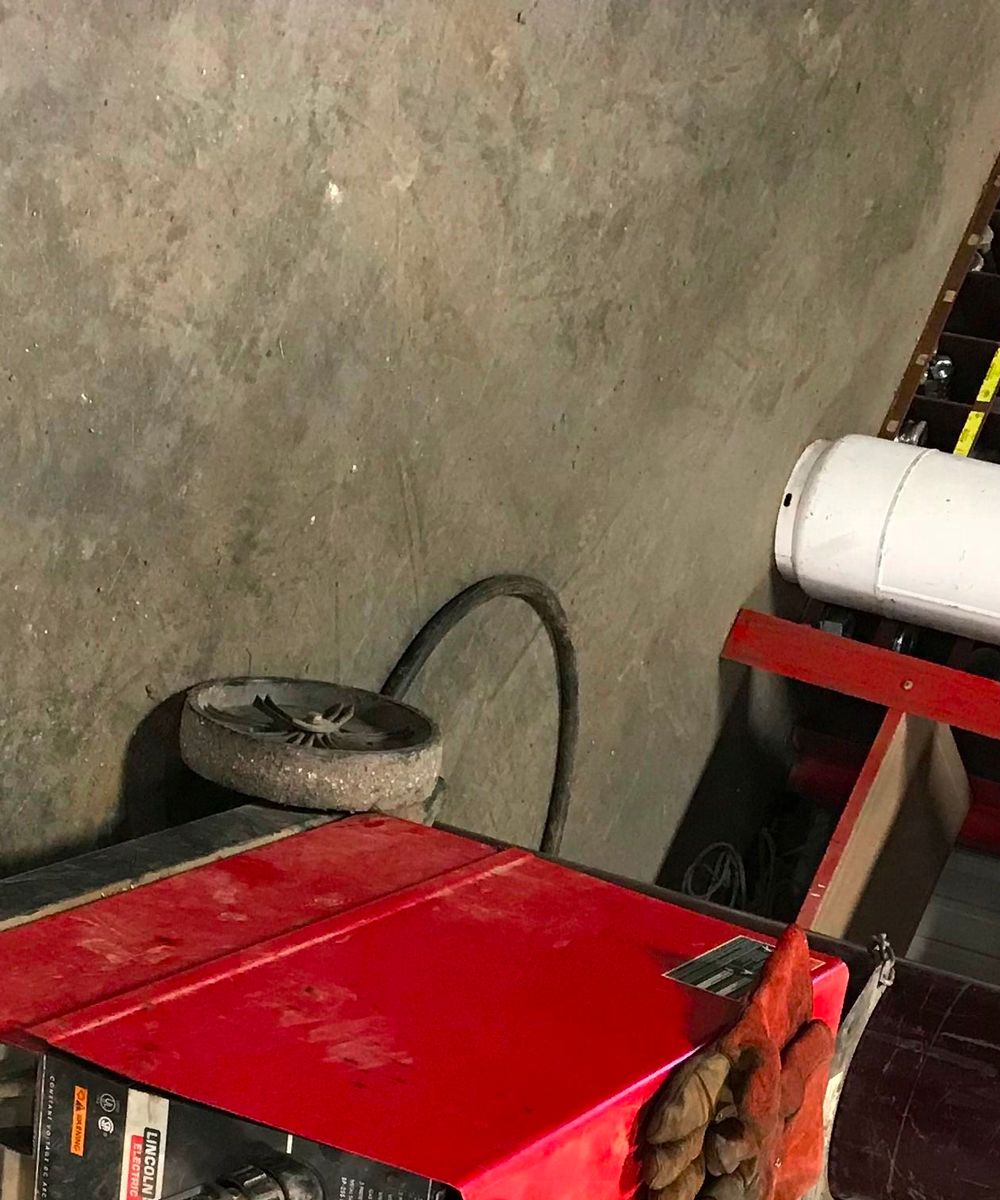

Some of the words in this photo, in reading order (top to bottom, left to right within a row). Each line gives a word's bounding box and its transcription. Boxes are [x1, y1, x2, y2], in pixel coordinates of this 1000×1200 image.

[73, 1113, 83, 1151] WARNING
[129, 1142, 143, 1197] ELECTRIC
[141, 1131, 157, 1196] LINCOLN
